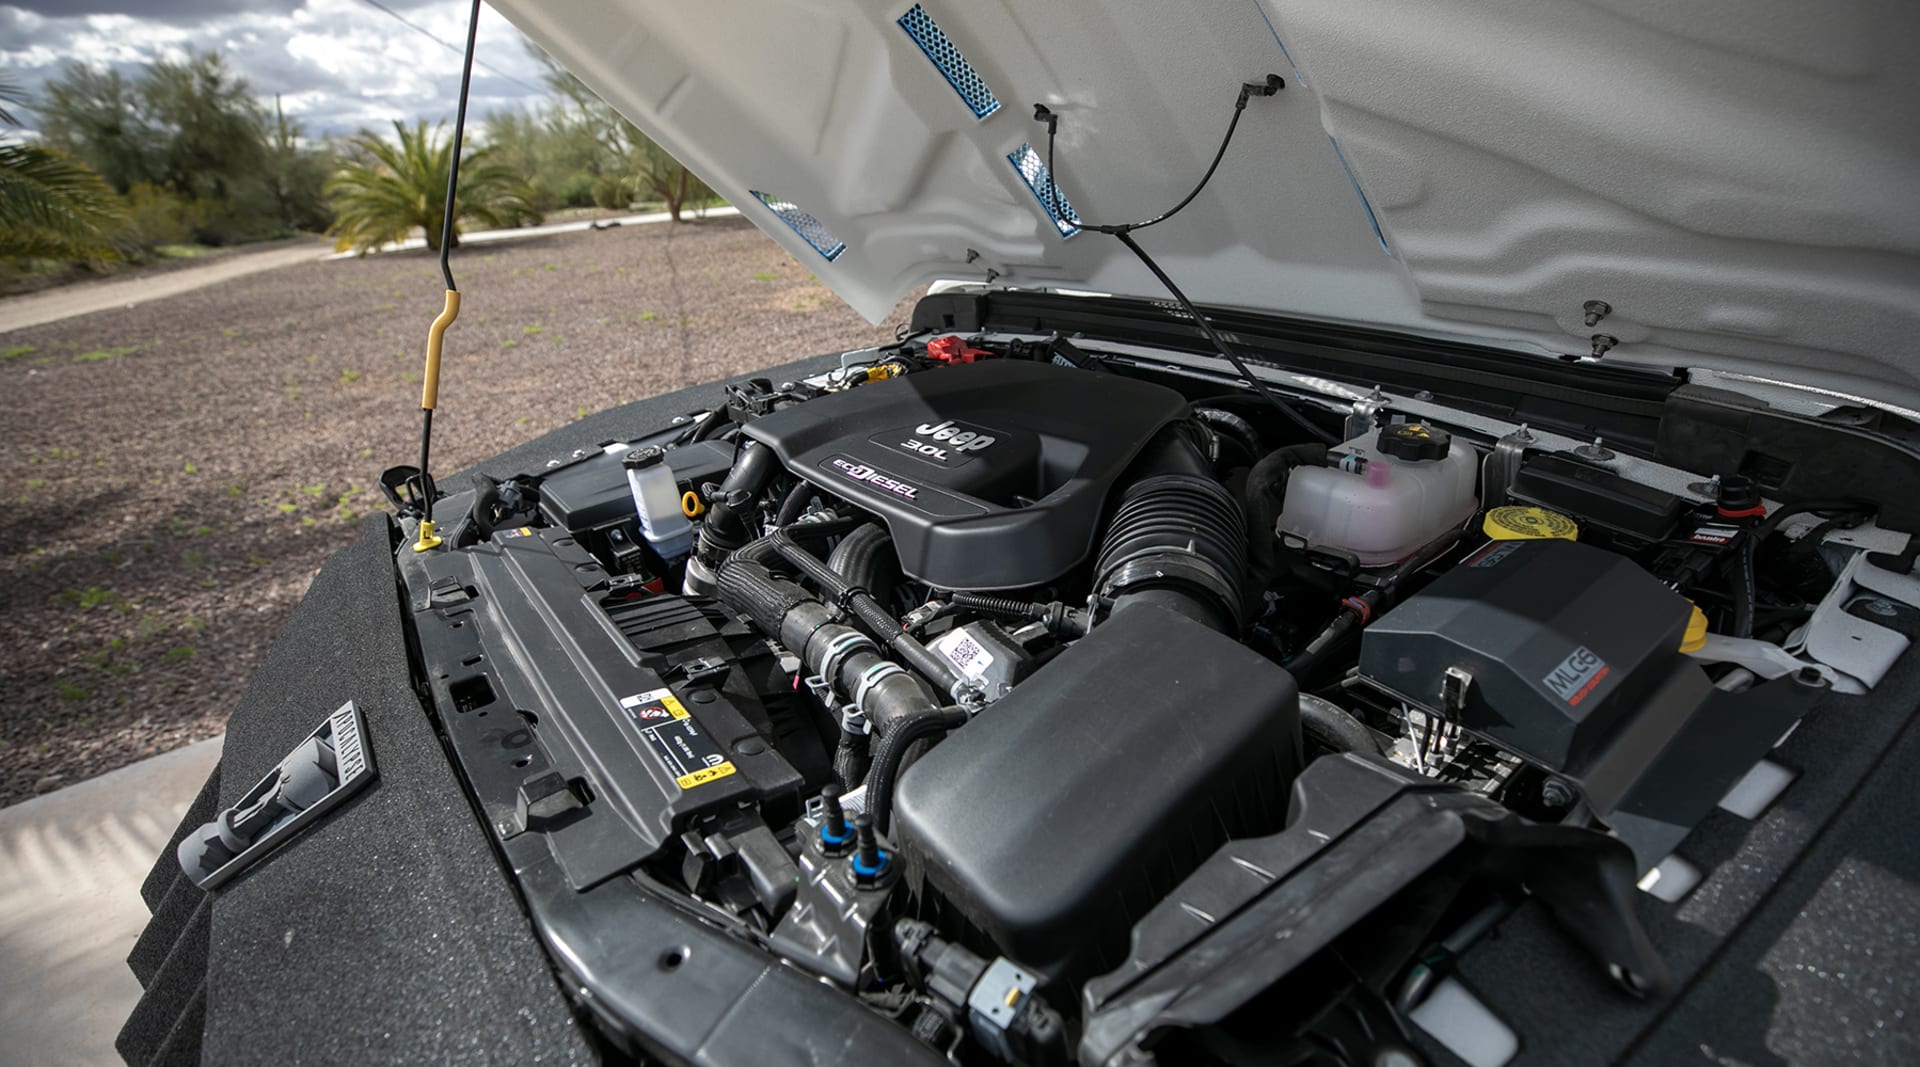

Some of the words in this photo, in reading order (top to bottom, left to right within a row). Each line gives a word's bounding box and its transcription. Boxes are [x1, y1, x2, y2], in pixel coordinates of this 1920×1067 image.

[900, 438, 948, 461] 3.0L
[915, 420, 995, 452] Jeep
[333, 709, 364, 781] APOCALYPSE
